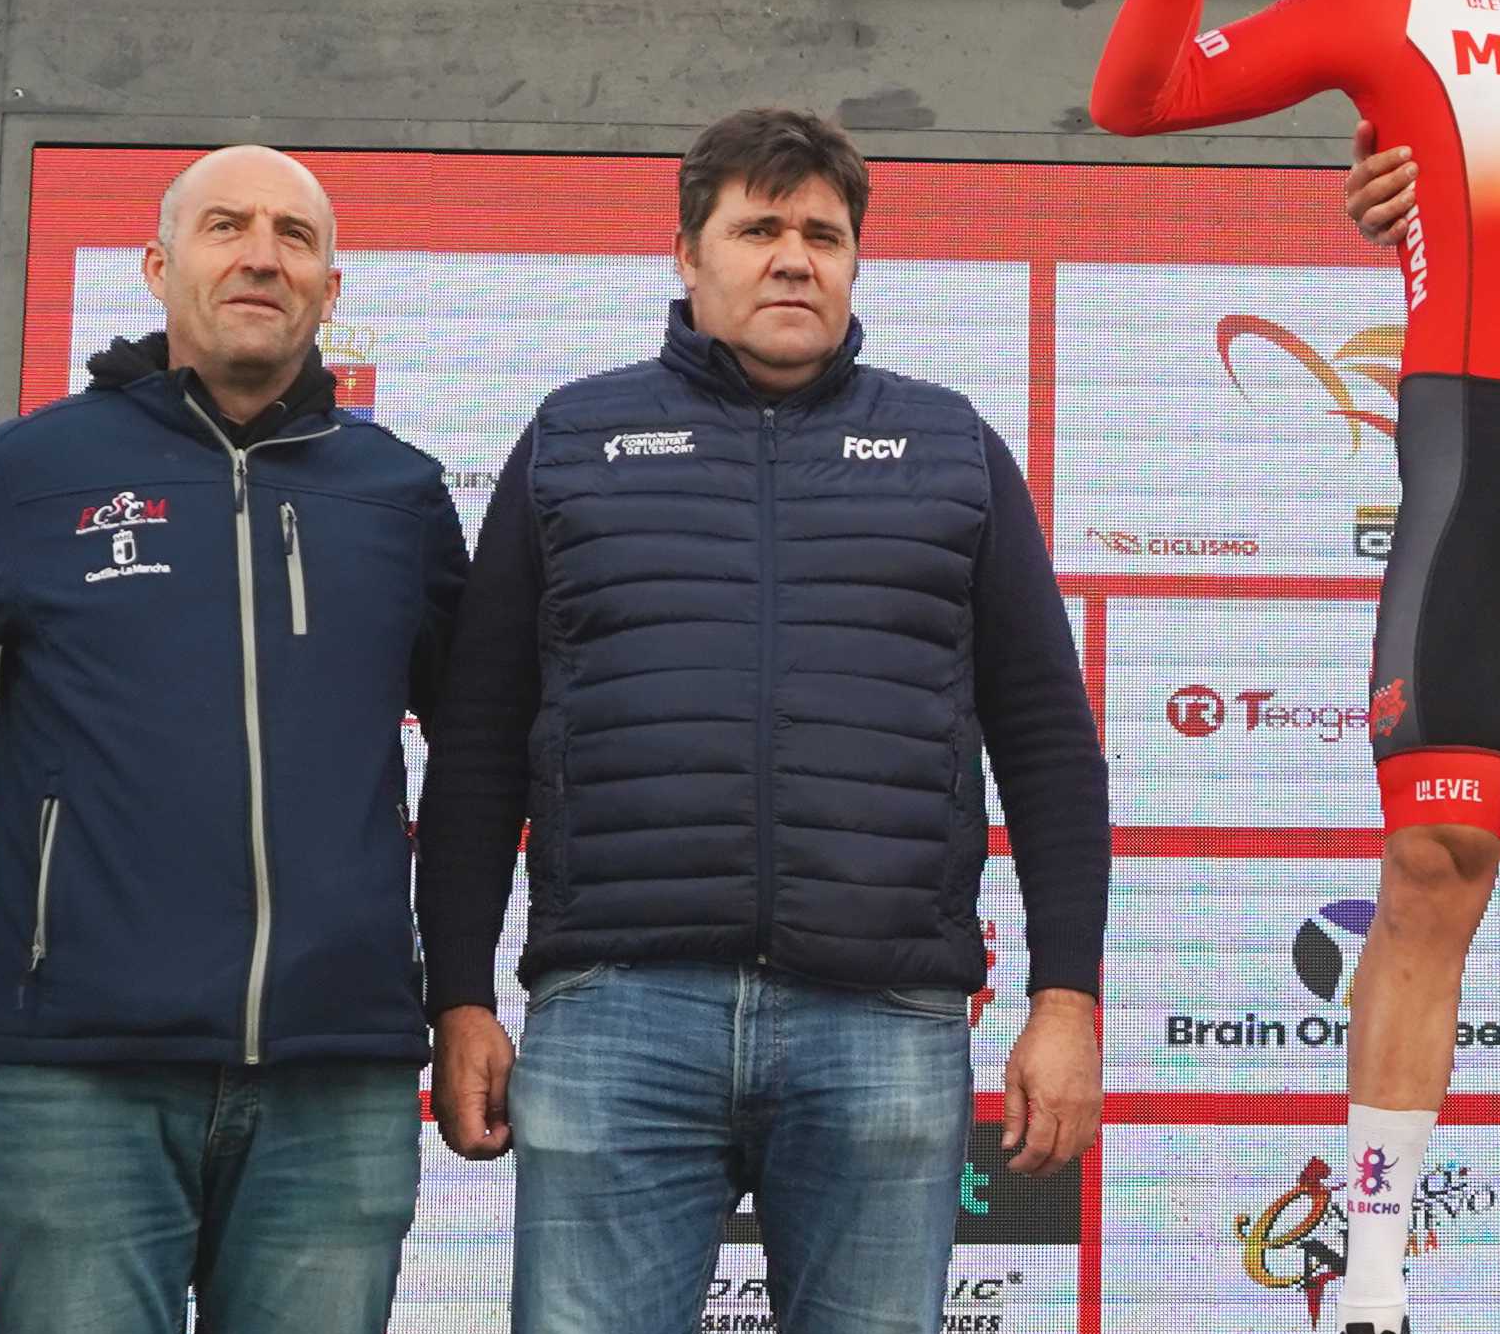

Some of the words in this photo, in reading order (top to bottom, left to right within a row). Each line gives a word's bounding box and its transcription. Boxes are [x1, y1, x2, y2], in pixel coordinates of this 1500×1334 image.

[843, 436, 907, 459] FCCV
[1168, 1013, 1285, 1046] Brain
[1358, 1200, 1400, 1216] BICHO
